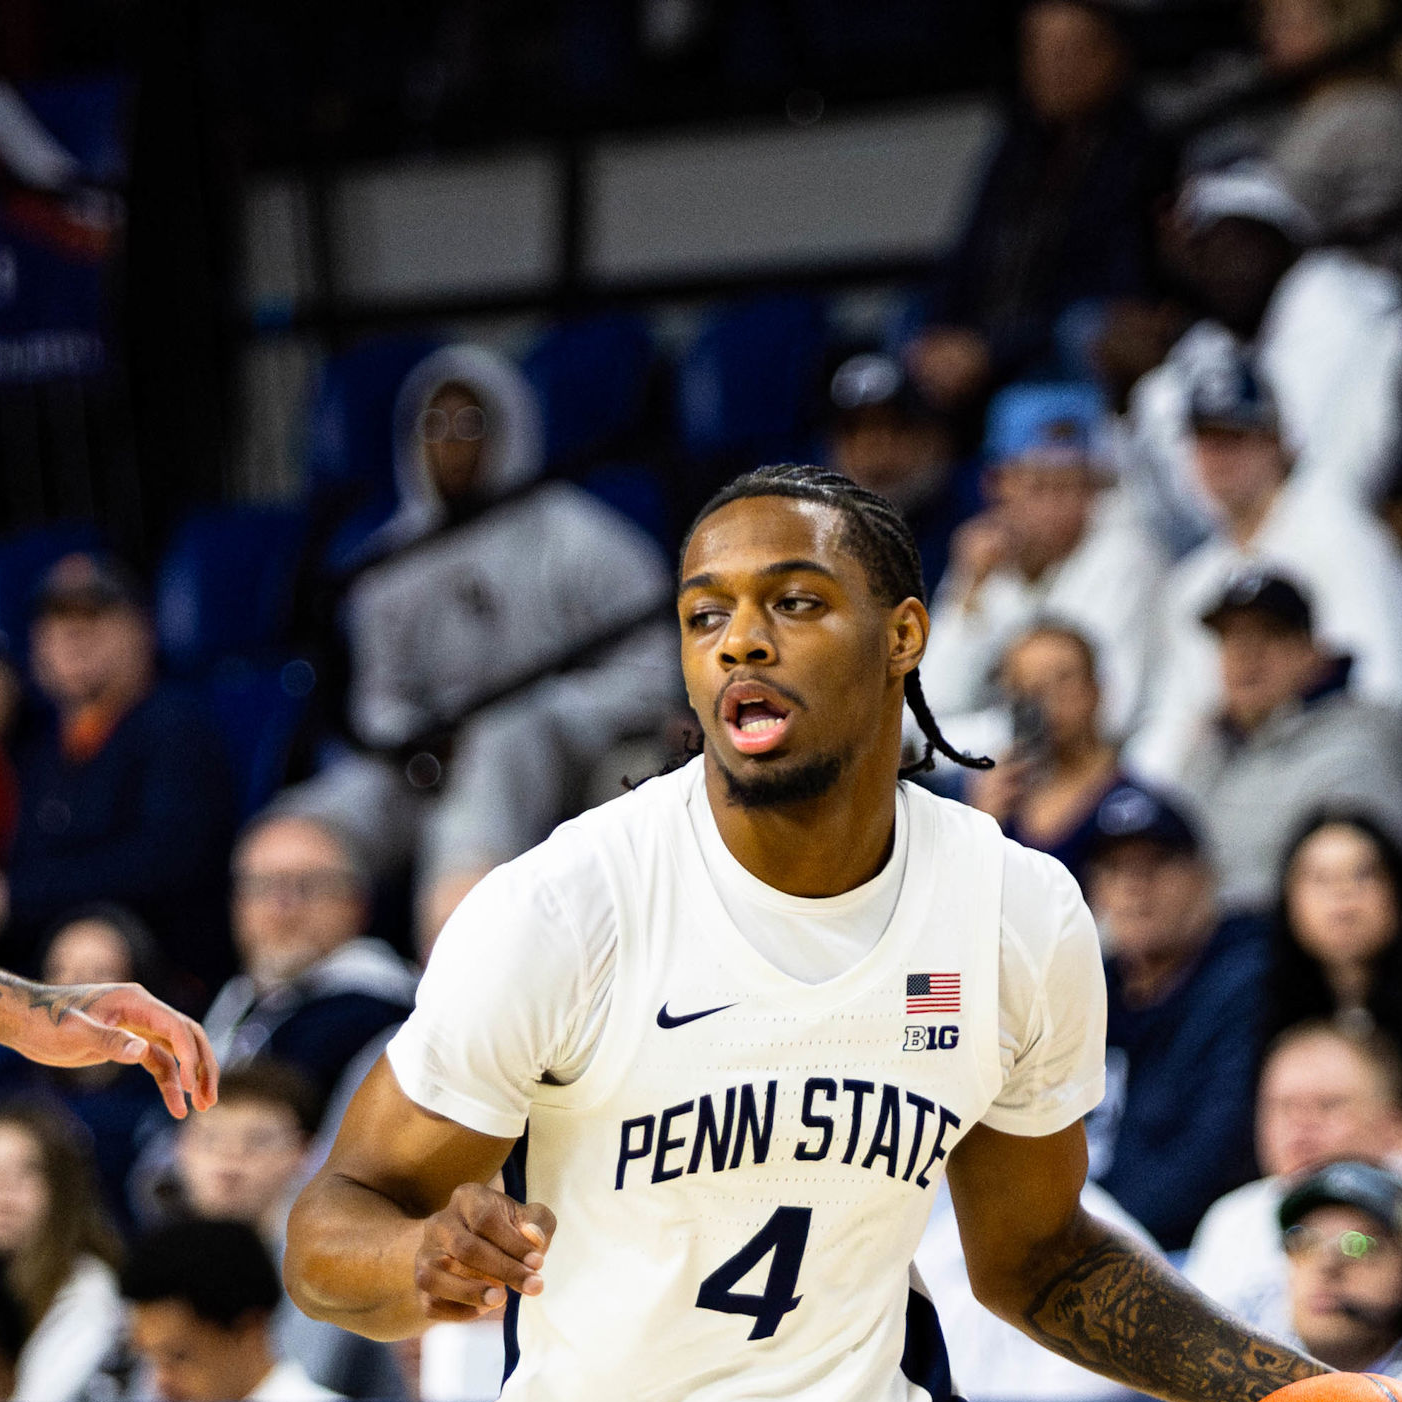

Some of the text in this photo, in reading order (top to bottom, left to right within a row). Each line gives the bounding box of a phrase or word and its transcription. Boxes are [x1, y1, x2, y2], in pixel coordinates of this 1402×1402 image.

[613, 1076, 961, 1191] PENN STATE
[694, 1204, 813, 1342] 4
